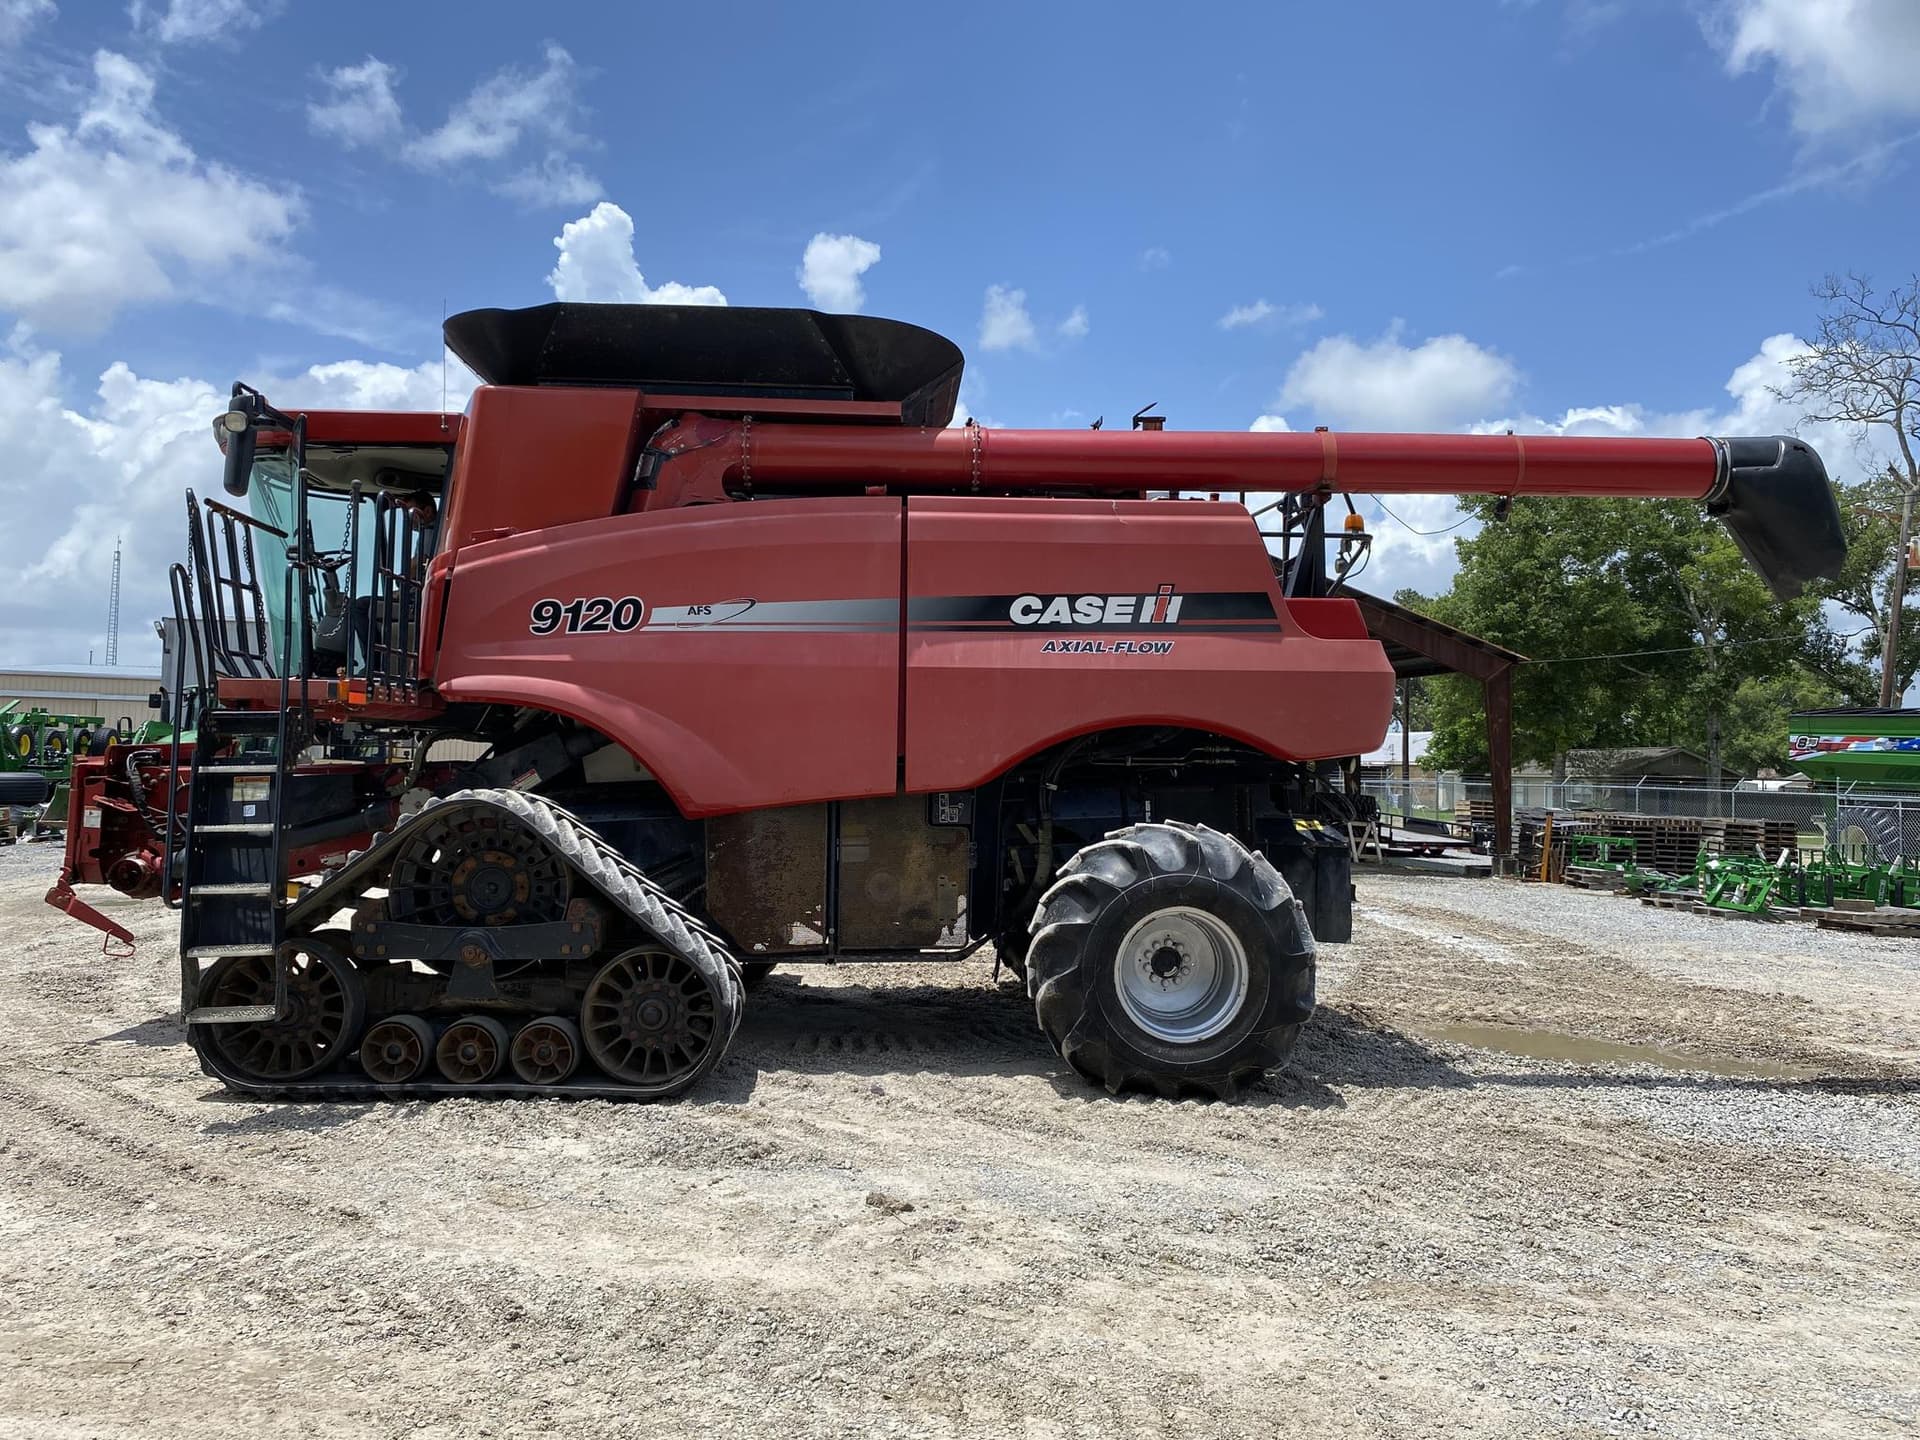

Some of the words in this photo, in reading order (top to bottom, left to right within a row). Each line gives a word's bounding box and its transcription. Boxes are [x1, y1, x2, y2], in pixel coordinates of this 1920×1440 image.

[530, 597, 644, 635] 9120
[687, 605, 712, 616] AFS
[1009, 595, 1136, 624] CASE
[1040, 639, 1175, 654] AXIAL-FLOW
